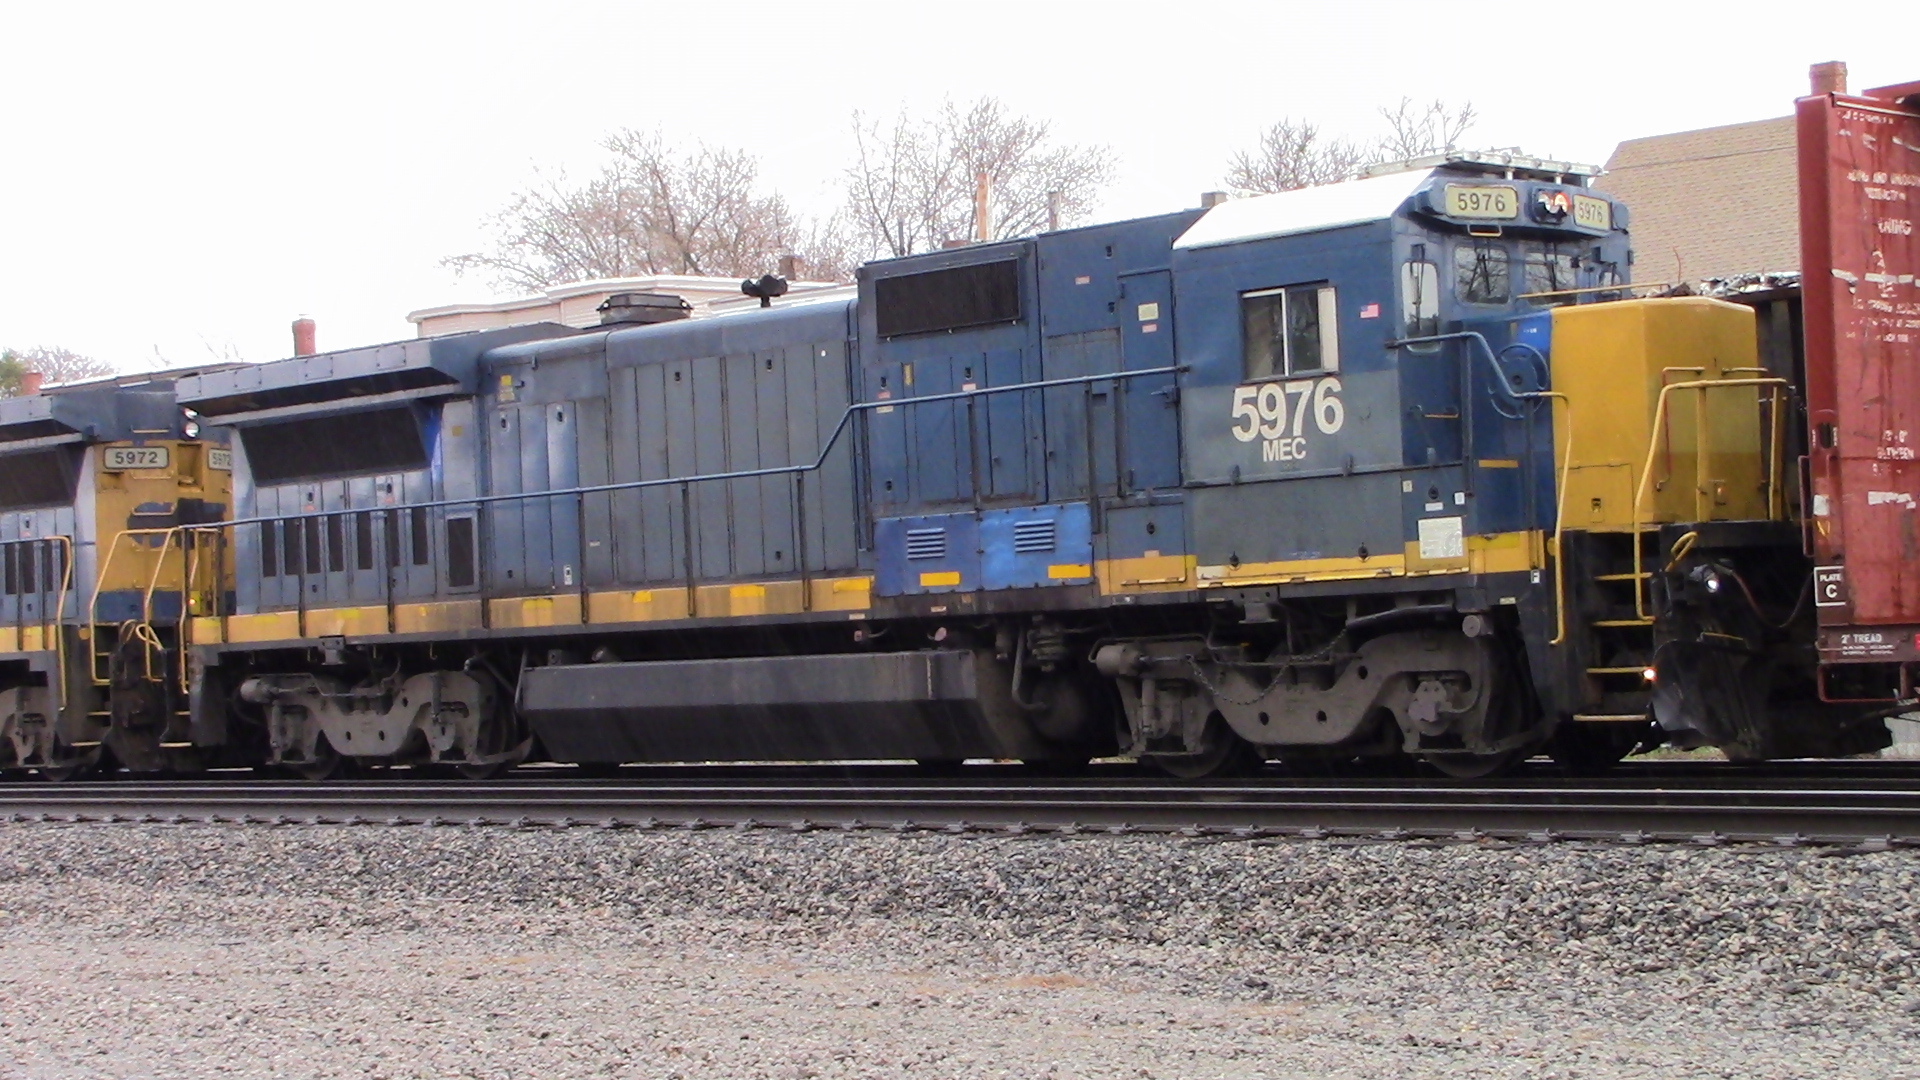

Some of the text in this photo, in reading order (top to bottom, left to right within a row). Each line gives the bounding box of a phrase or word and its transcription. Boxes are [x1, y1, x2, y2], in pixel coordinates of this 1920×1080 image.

[1457, 192, 1506, 212] 5976
[1578, 202, 1603, 223] 5976
[1231, 376, 1344, 442] 5976
[114, 451, 158, 465] 5972
[1262, 437, 1307, 462] MEC
[1819, 573, 1842, 582] PLATE
[1825, 583, 1838, 599] C
[1853, 633, 1882, 643] TREAD
